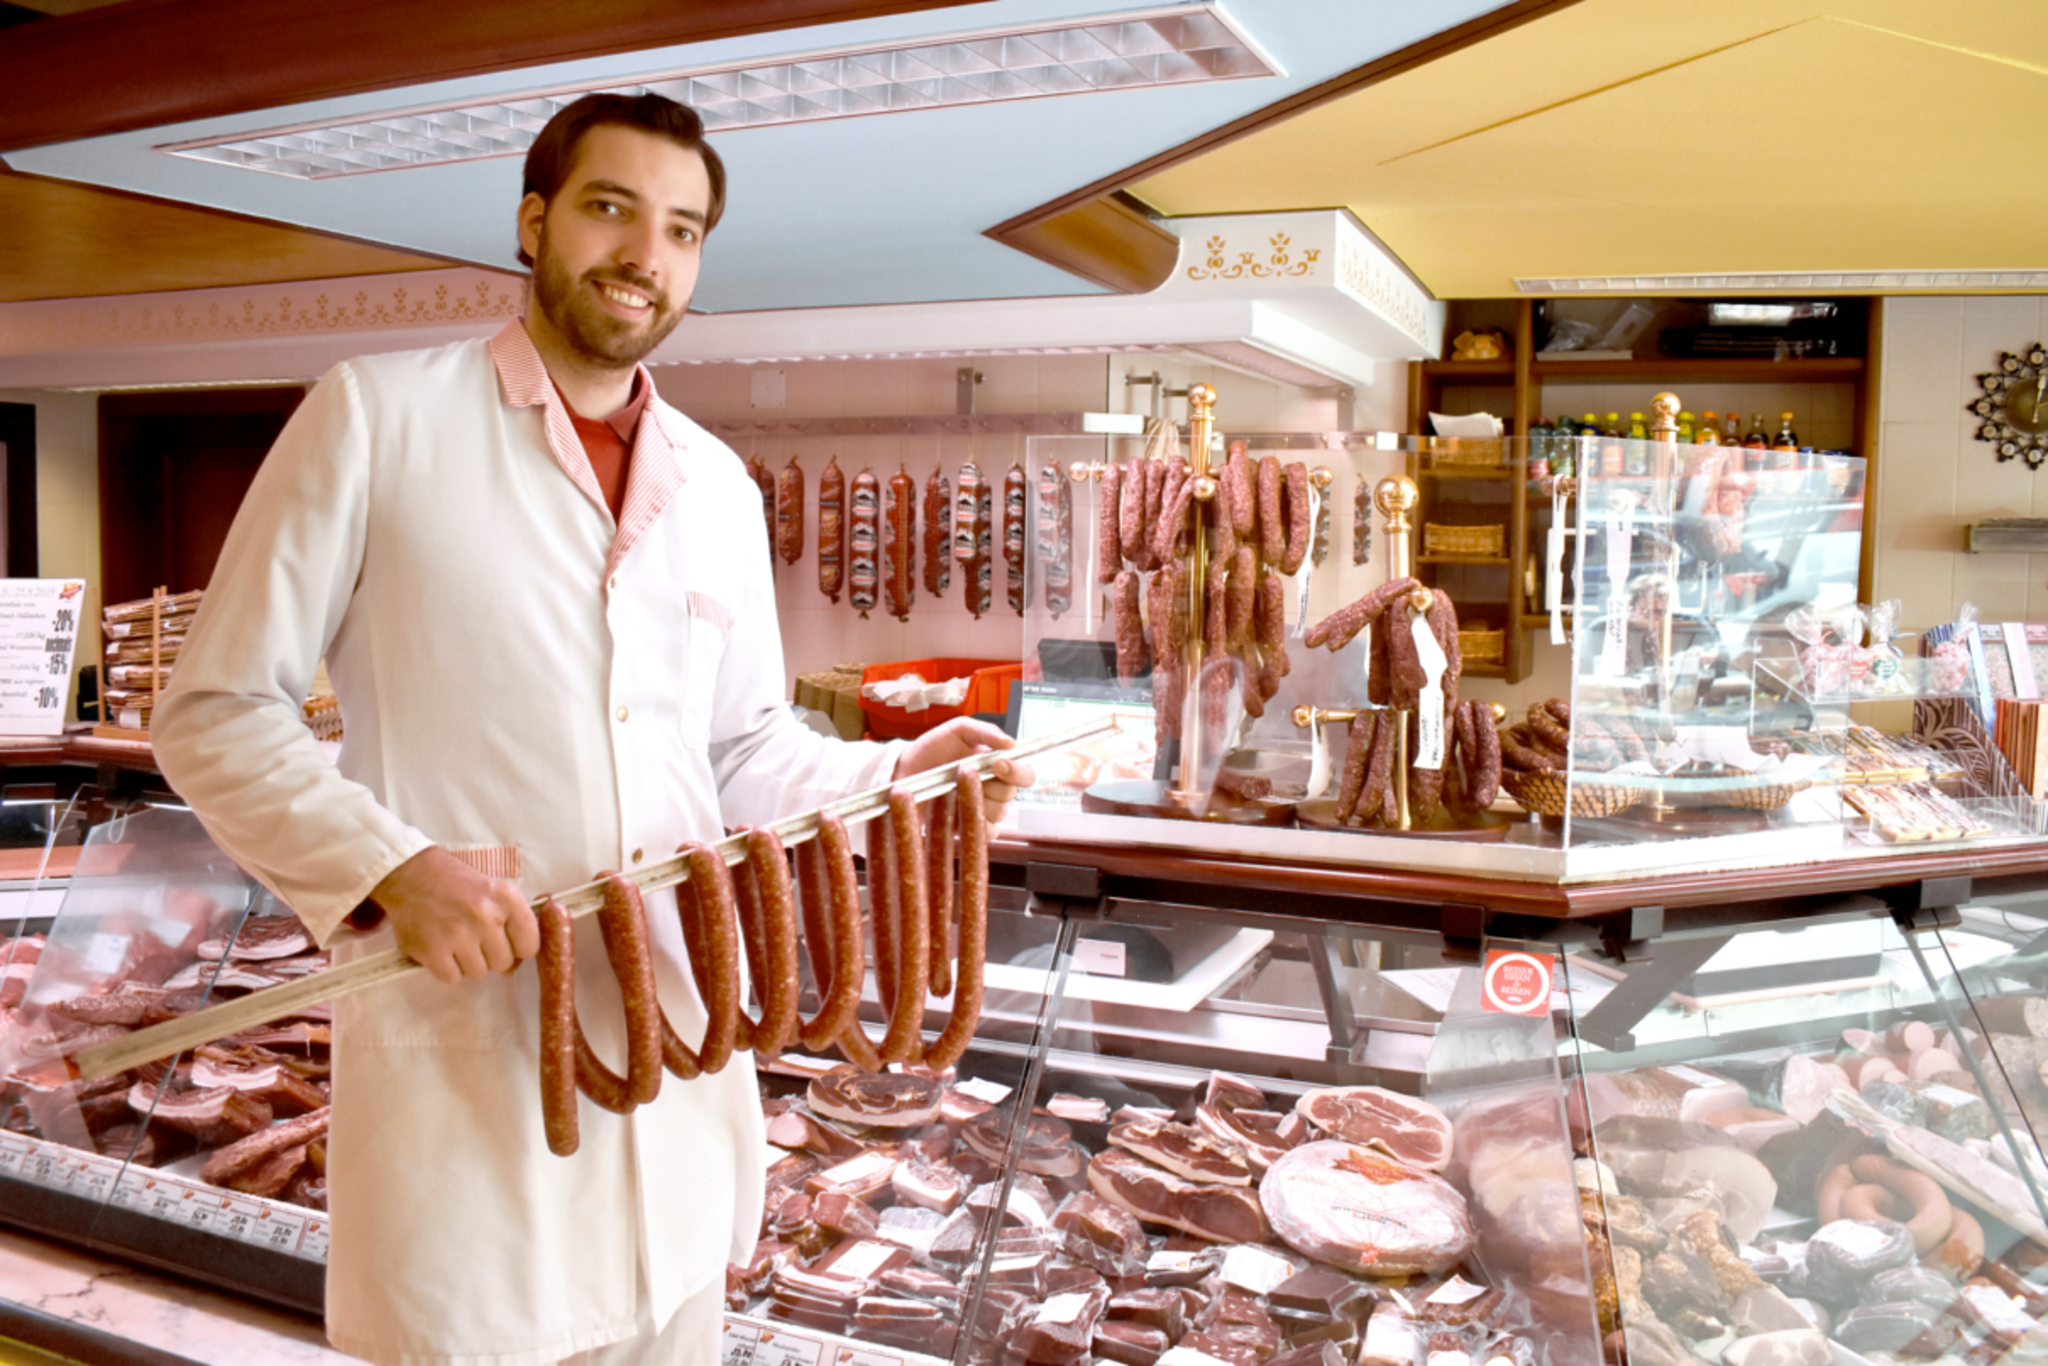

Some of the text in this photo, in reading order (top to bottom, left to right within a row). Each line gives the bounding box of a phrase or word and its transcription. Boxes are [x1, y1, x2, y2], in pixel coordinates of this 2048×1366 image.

[52, 609, 74, 632] -20%
[46, 653, 68, 675] -15%
[34, 687, 59, 709] -10%
[1503, 965, 1534, 976] BESSER
[1504, 972, 1531, 982] ESSEN
